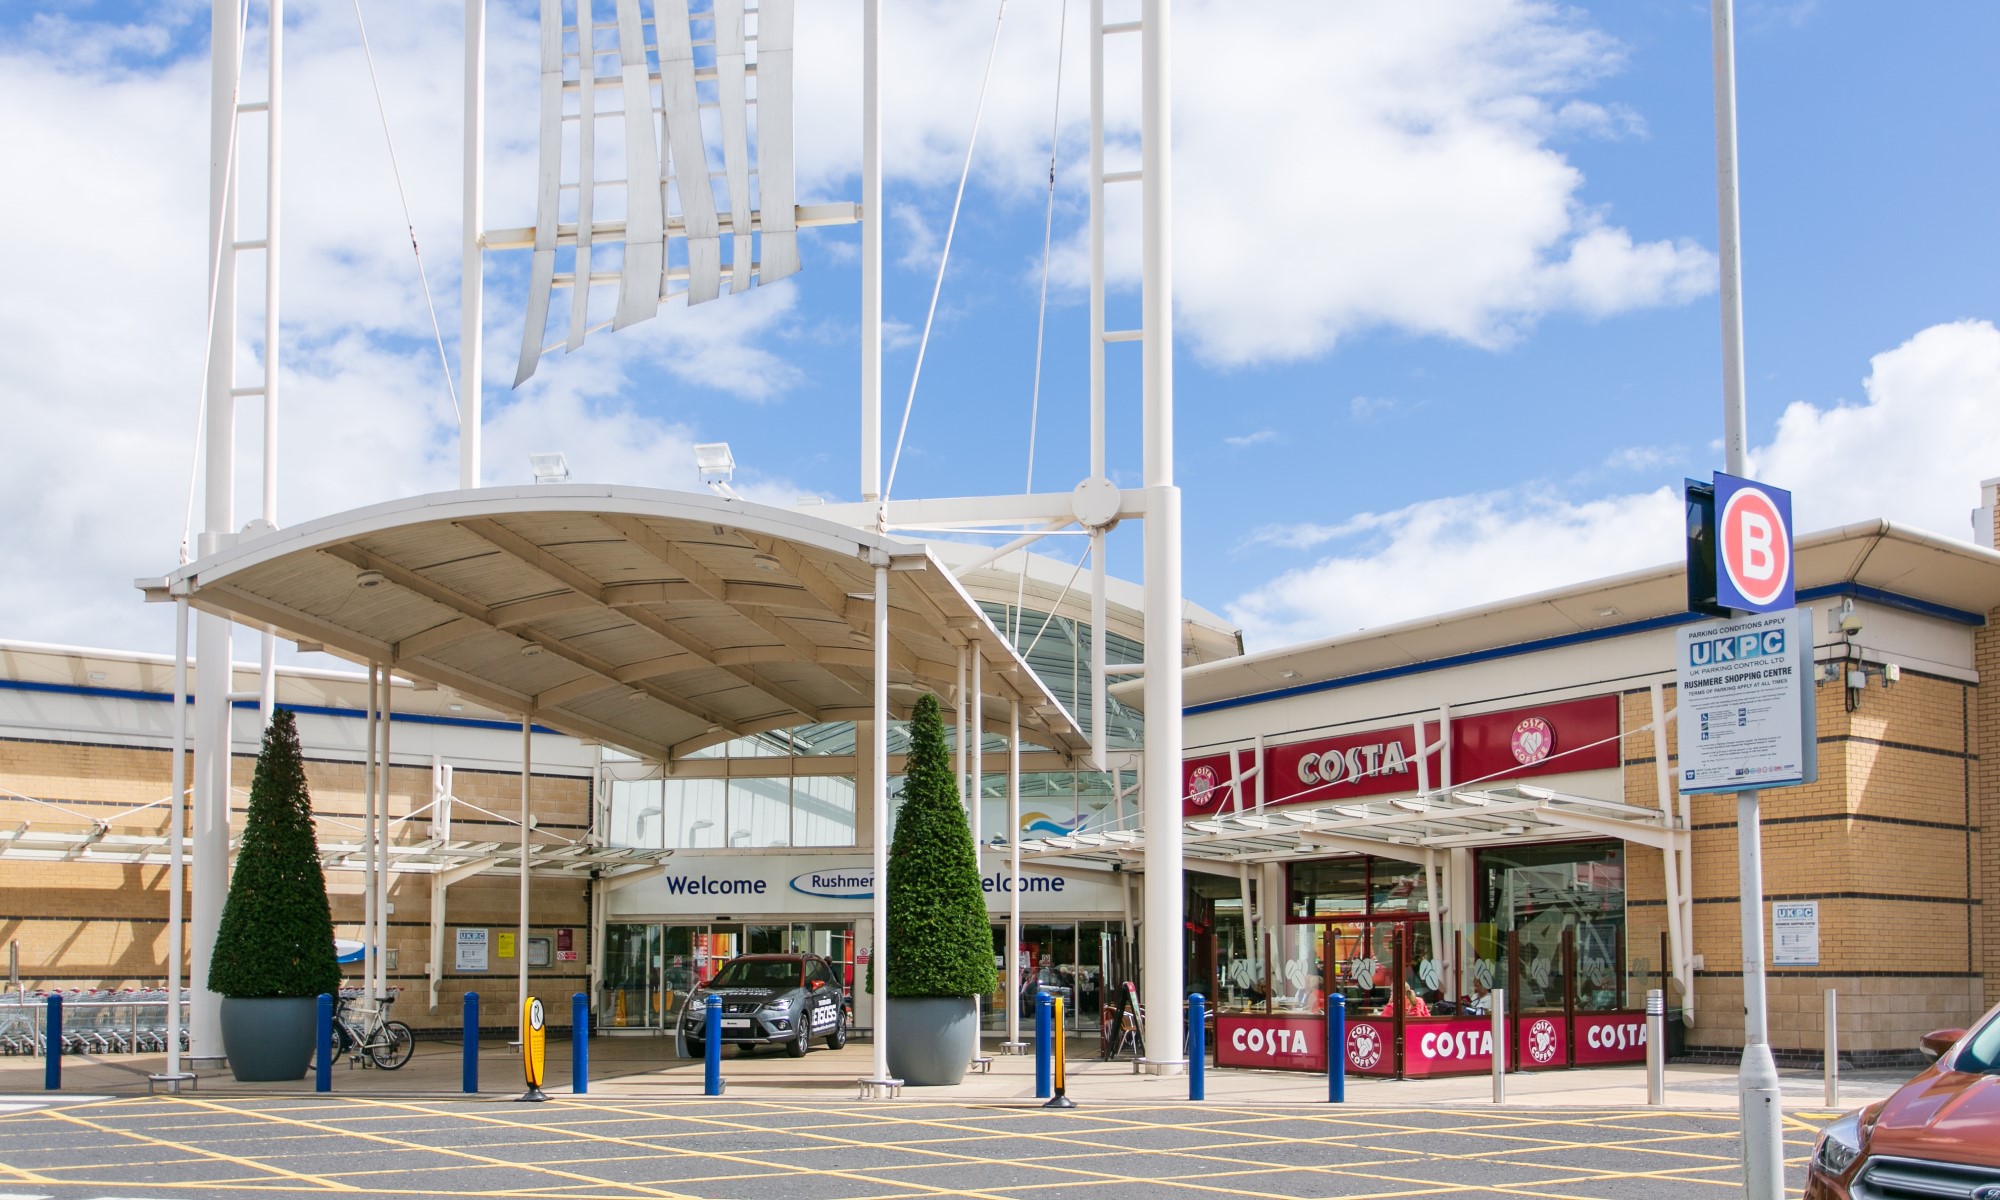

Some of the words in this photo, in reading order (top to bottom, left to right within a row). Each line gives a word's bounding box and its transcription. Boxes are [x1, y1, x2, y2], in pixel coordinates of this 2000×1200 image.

[1741, 510, 1775, 581] B
[1688, 628, 1718, 639] PARKING
[1719, 621, 1762, 634] CONDITIONS
[1763, 617, 1786, 627] APPLY
[1692, 630, 1783, 665] UKPC
[1689, 669, 1700, 677] UK
[1701, 664, 1733, 674] PARKING
[1733, 659, 1769, 670] CONTROL
[1770, 656, 1785, 664] LTD
[1684, 676, 1723, 690] RUSHMERE
[1724, 670, 1762, 685] SHOPPING
[1763, 666, 1792, 678] CENTRE
[1688, 689, 1705, 697] TERMS
[1714, 685, 1736, 693] PARKING
[1517, 718, 1544, 733] COSTA
[1297, 741, 1408, 785] COSTA
[1514, 746, 1548, 763] COFFEE
[666, 875, 767, 895] Welcome
[812, 874, 874, 888] Rushmer
[981, 872, 1065, 892] elcome
[1778, 908, 1812, 918] UKPC
[1351, 1025, 1376, 1040] COSTA
[1532, 1021, 1552, 1035] COSTA
[1588, 1023, 1647, 1050] COSTA
[1232, 1027, 1308, 1056] COSTA
[1421, 1030, 1493, 1060] COSTA
[1350, 1050, 1379, 1067] COFFEE
